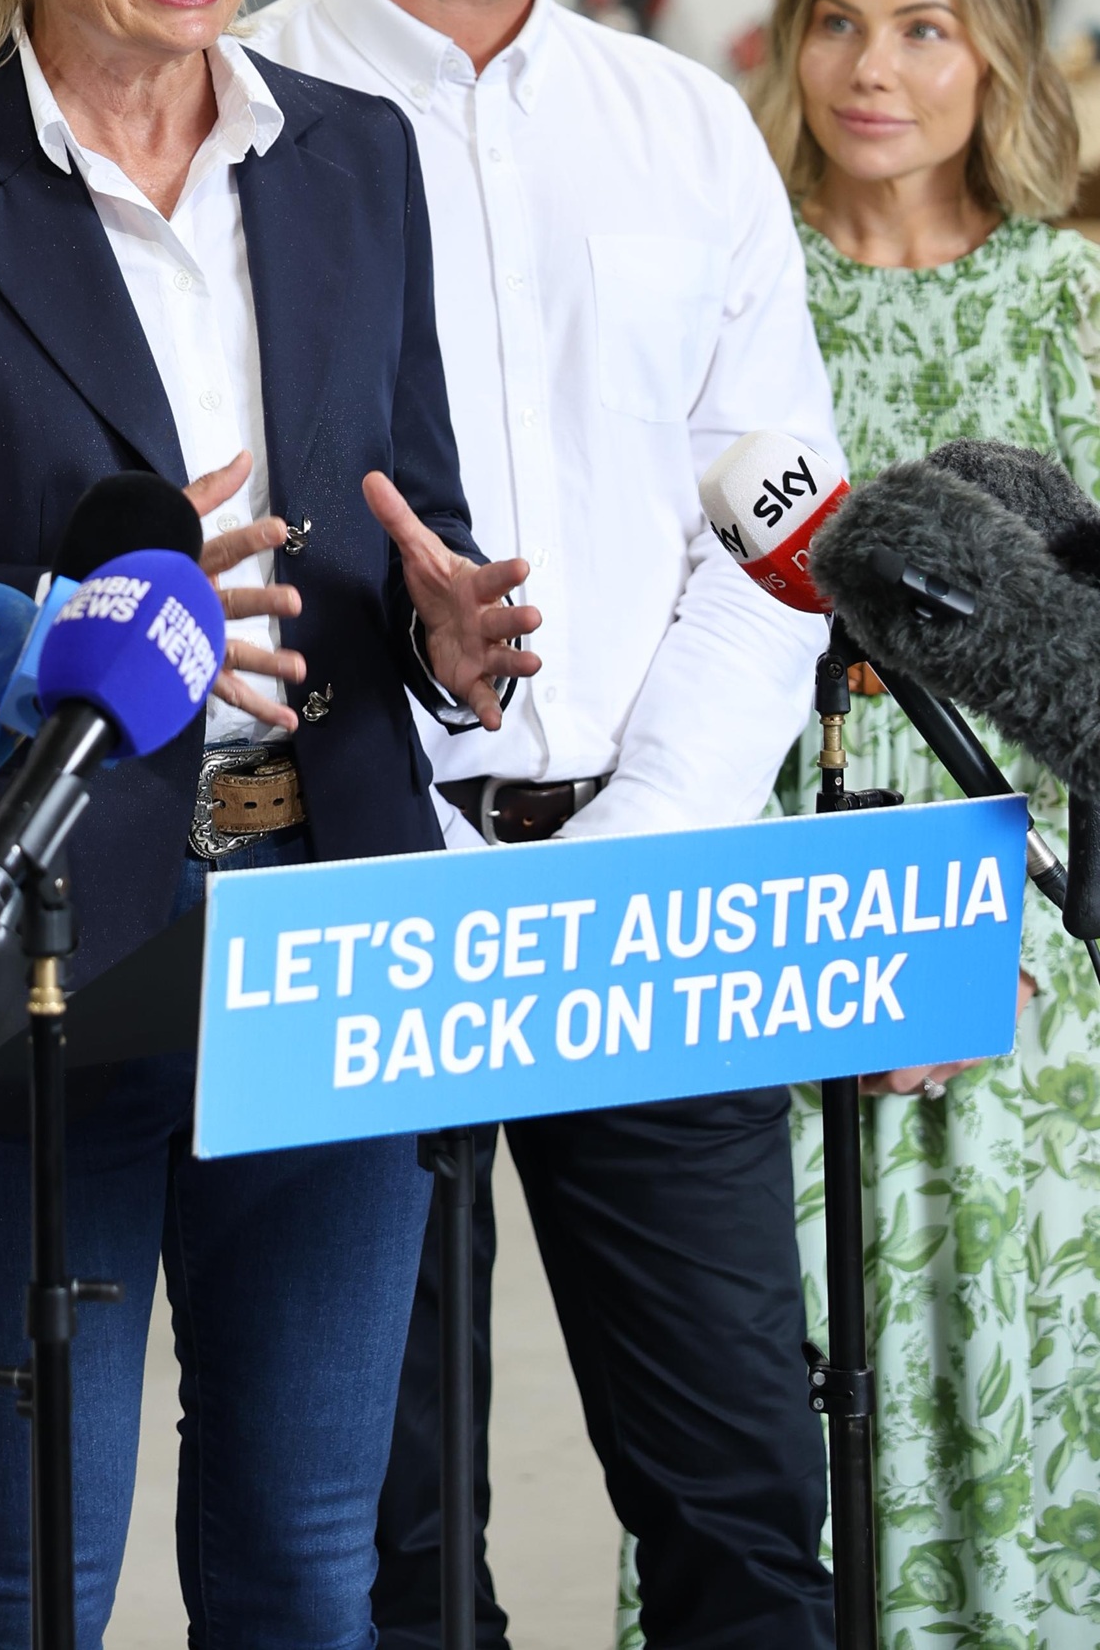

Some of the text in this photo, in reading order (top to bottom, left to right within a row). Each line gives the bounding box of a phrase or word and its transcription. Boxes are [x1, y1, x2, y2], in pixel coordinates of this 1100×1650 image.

[753, 455, 818, 529] sky
[710, 520, 749, 559] ky
[54, 596, 140, 626] NEWS
[146, 614, 208, 705] NEWS
[453, 898, 597, 983] GET
[610, 856, 1009, 966] AUSTRALIA
[332, 952, 908, 1089] BACK ON TRACK
